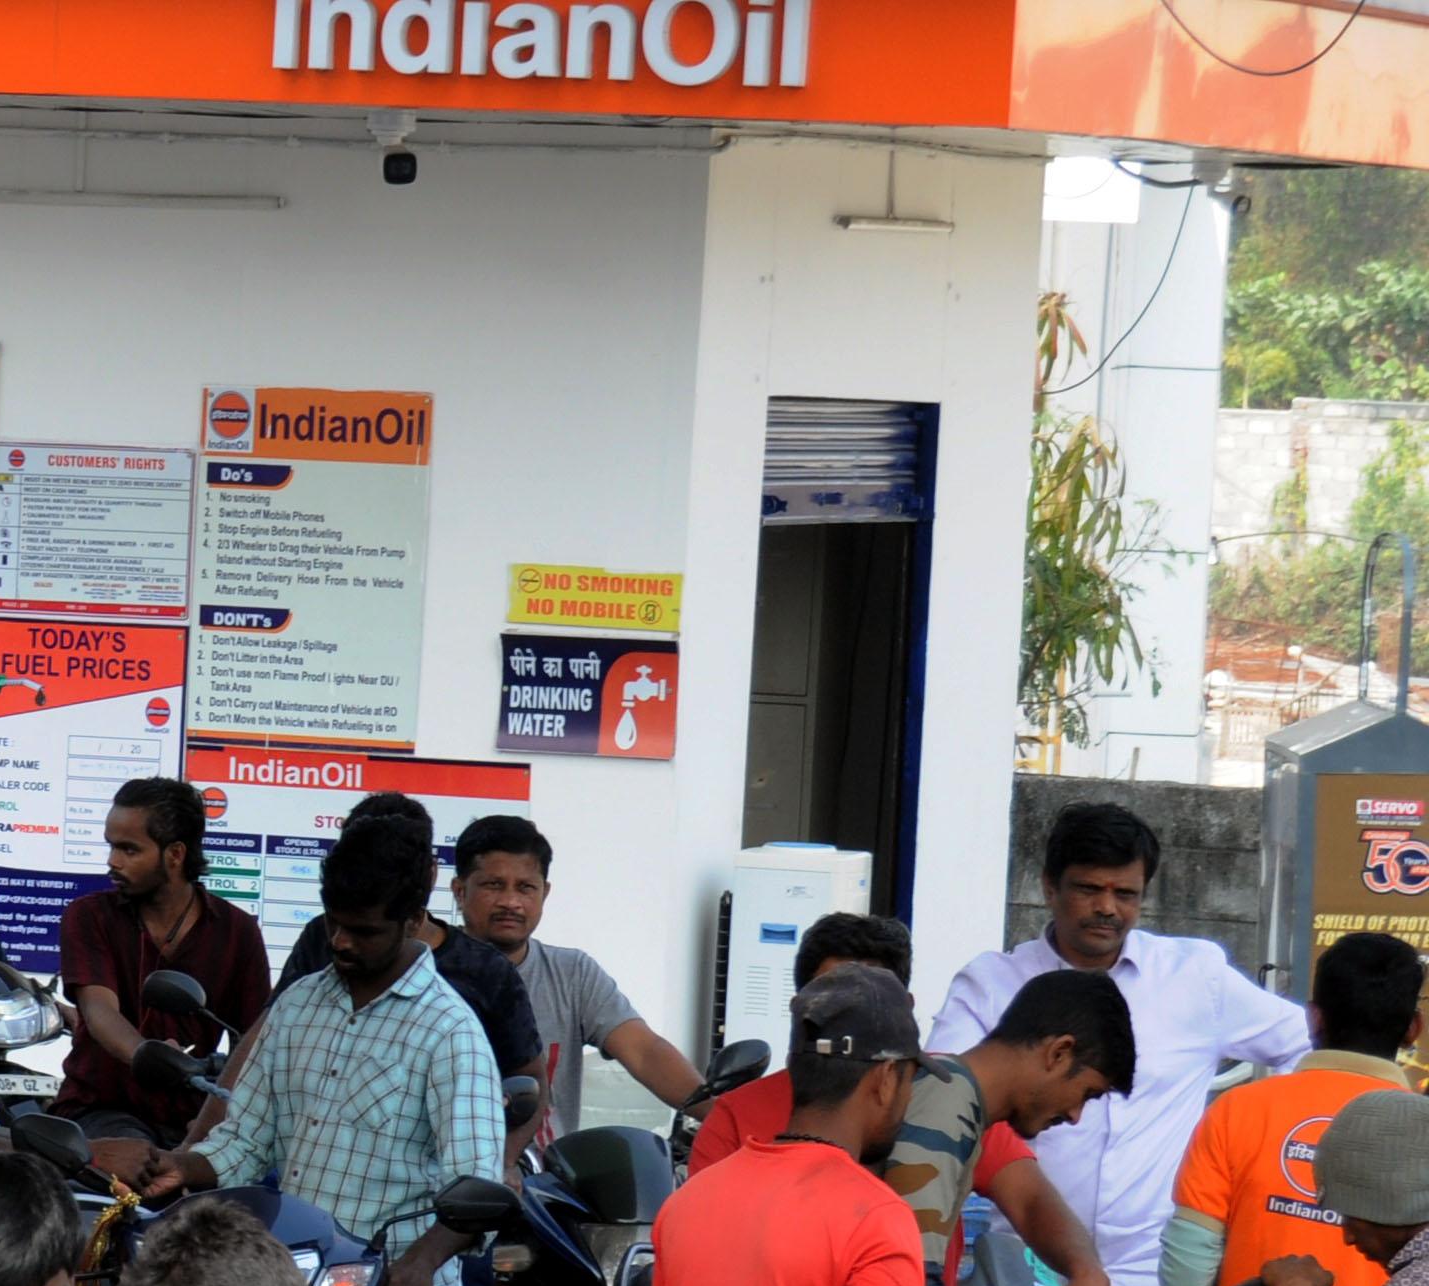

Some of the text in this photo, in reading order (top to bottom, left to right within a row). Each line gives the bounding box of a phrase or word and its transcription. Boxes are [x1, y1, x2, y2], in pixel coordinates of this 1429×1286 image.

[272, 0, 811, 87] IndianOil
[259, 403, 425, 445] IndianOil
[48, 455, 165, 471] CUSTOMERS' RIGHTS
[220, 467, 253, 482] Do's
[219, 493, 271, 506] No smoking
[219, 508, 325, 522] Switch off Mobile Phones
[218, 524, 342, 541] Stop Engine Before Refueling
[217, 540, 405, 560] 2/3 Wheeler to Drag their Vehicle From Pump
[216, 554, 343, 571] Island without Starting Engine
[216, 570, 404, 589] Remove Delivery Hose From the Vehicle
[544, 573, 673, 596] NO SMOKING
[215, 585, 278, 599] After Refueling
[527, 598, 636, 620] NO MOBILE
[28, 628, 126, 652] TODAY'S
[212, 635, 338, 653] Don't Allow Leakage Spillage
[2, 653, 151, 681] FUEL PRICES
[212, 650, 235, 661] Don't
[236, 652, 259, 663] Litter
[269, 654, 283, 665] the
[284, 655, 304, 665] Area
[510, 648, 601, 680] पीने का पानी
[211, 666, 393, 686] Don't use non Flame Proof Near DU
[211, 682, 252, 693] Tank Area
[209, 697, 232, 707] Don't
[234, 699, 257, 711] Carry
[259, 701, 273, 710] out
[274, 701, 329, 713] Maintenance
[331, 703, 339, 713] of
[341, 704, 373, 716] Vehicle
[509, 685, 593, 711] DRINKING
[209, 712, 232, 723] Don't
[233, 714, 256, 725] Move
[258, 715, 272, 726] the
[274, 716, 305, 728] Vehicle
[307, 718, 330, 729] while
[332, 719, 373, 733] Refueling
[385, 724, 397, 732] on
[508, 713, 565, 737] WATER
[12, 760, 40, 770] NAME
[228, 756, 363, 788] IndianOil
[23, 781, 51, 792] CODE
[1373, 801, 1418, 815] SERVO
[227, 838, 255, 848] BOARD
[1313, 914, 1387, 931] SHIELD OF
[1269, 1197, 1343, 1225] IndianOi
